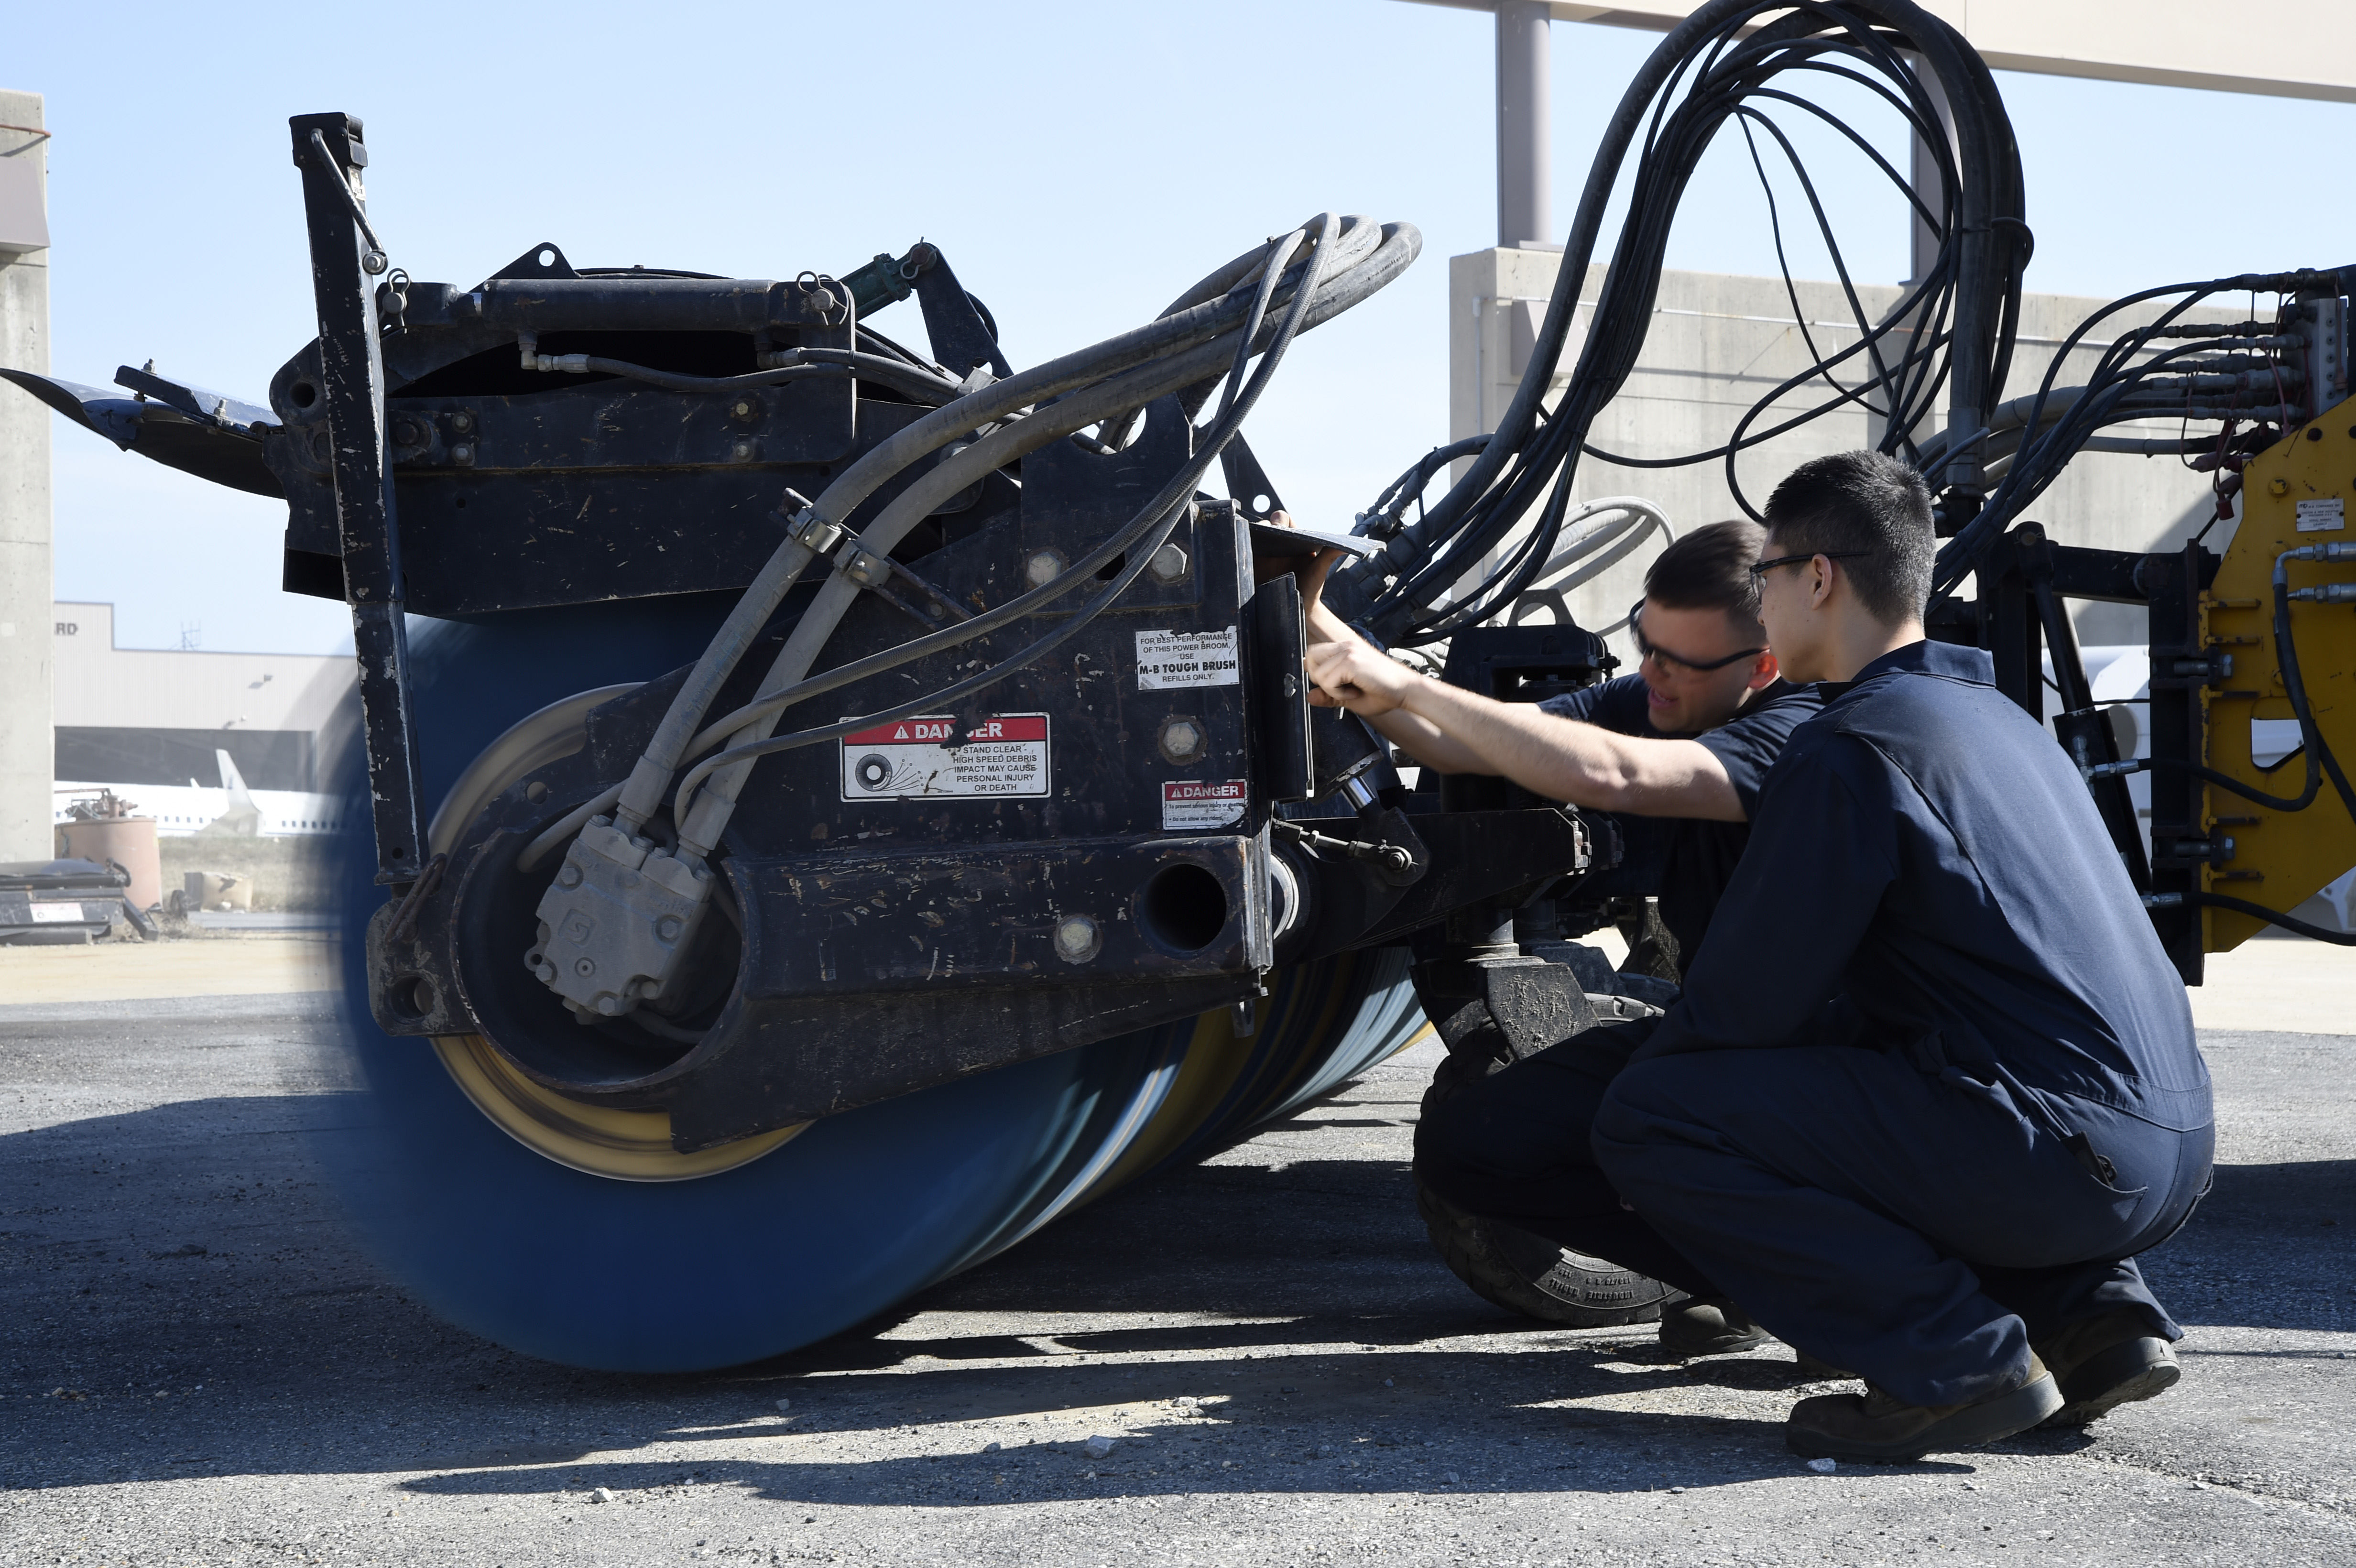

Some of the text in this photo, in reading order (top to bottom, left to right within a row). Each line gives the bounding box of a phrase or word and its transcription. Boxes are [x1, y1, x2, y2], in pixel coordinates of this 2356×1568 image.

[1140, 660, 1235, 675] M-B TOUGH BRUSH
[915, 723, 1003, 739] DANER
[1184, 785, 1239, 797] DANGER
